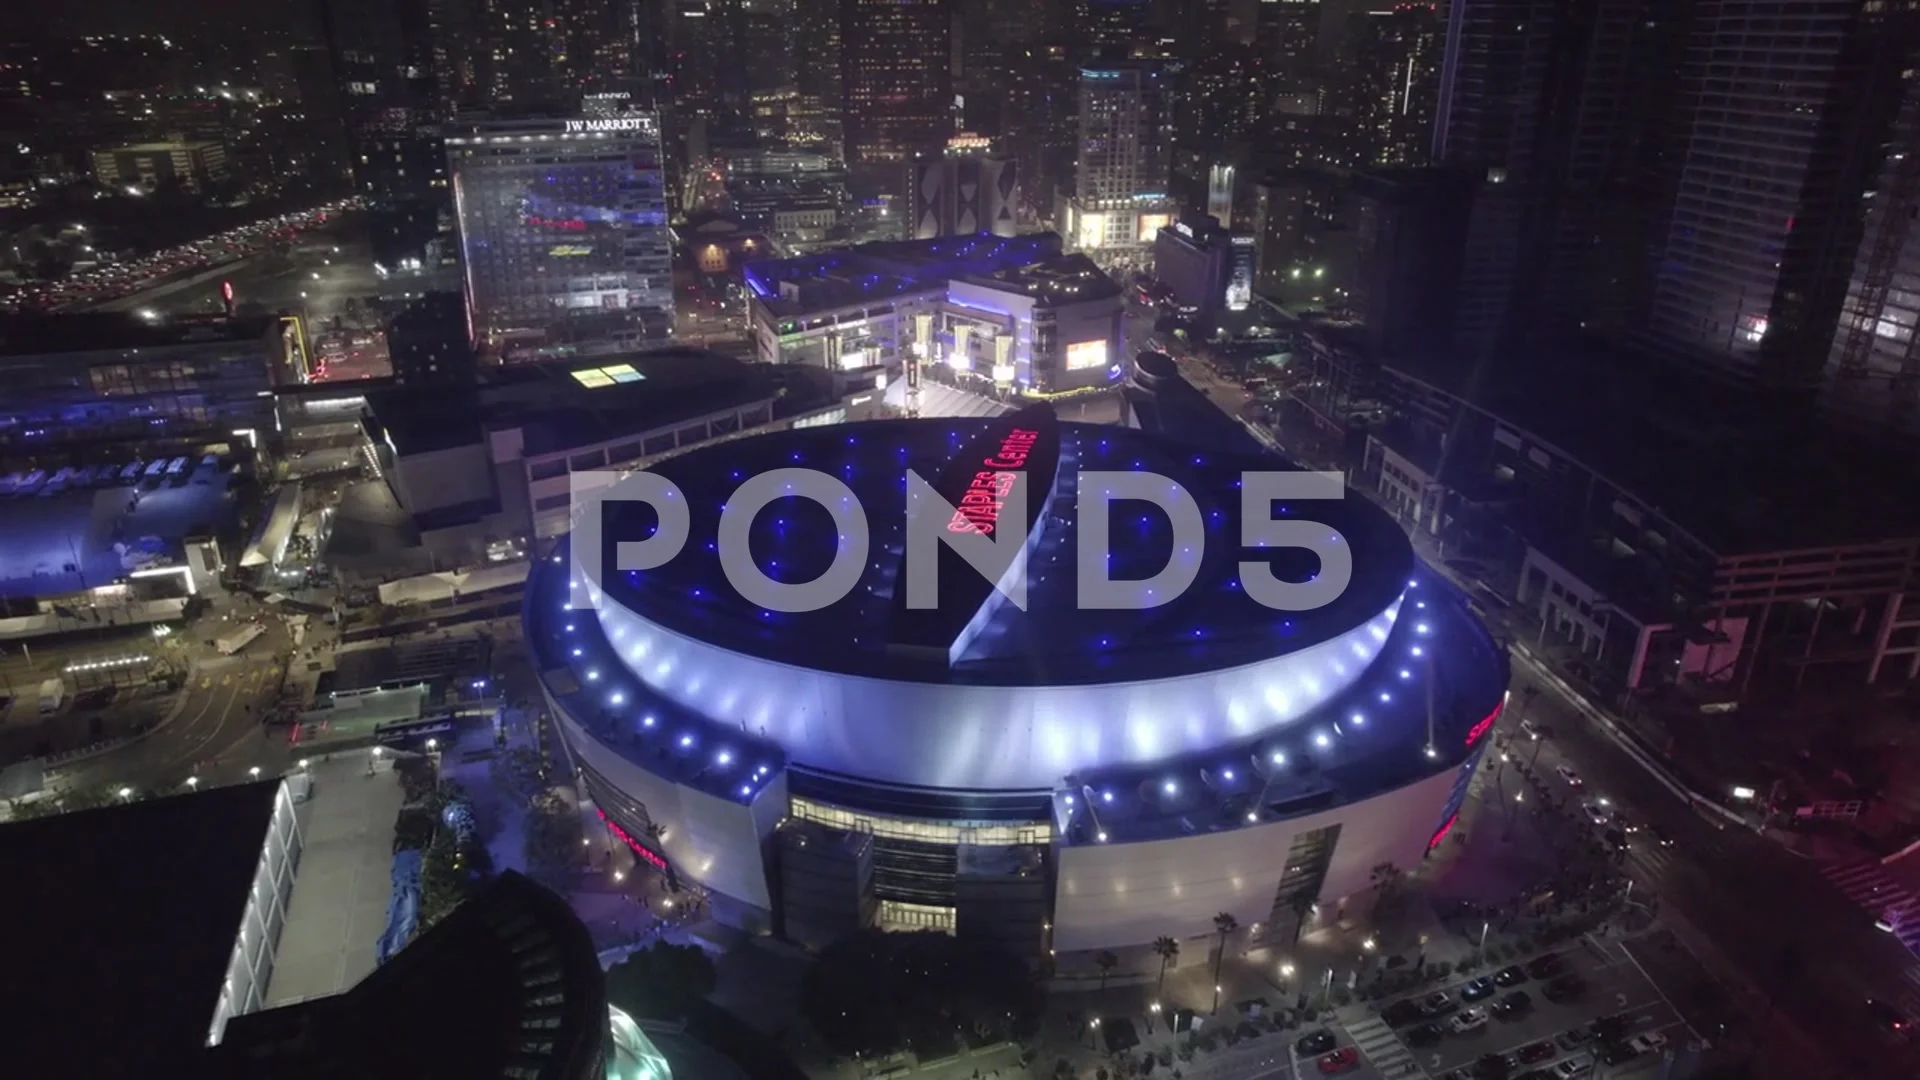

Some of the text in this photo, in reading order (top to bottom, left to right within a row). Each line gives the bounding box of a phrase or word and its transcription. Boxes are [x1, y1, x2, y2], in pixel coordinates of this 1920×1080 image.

[565, 118, 651, 132] JW MARRIOTT
[947, 428, 1039, 535] STAPLES Center
